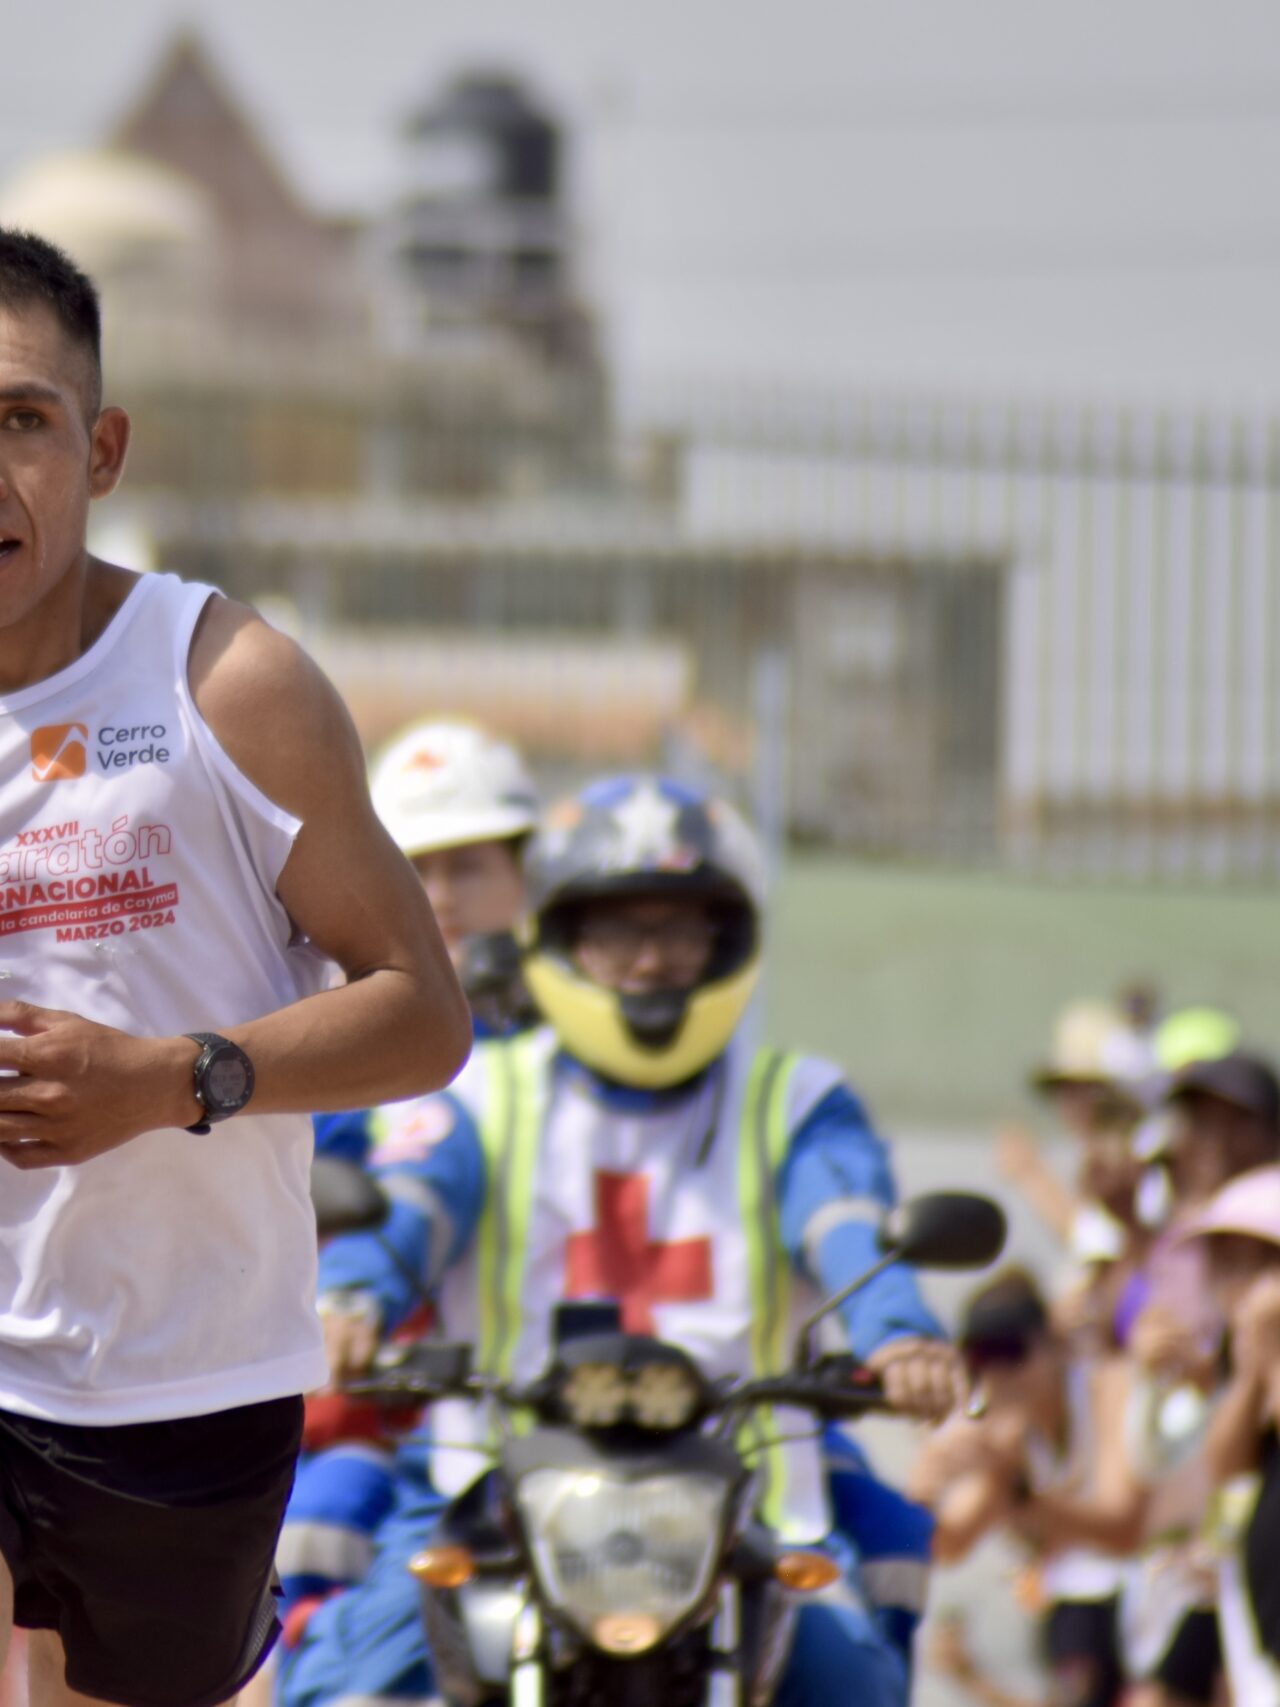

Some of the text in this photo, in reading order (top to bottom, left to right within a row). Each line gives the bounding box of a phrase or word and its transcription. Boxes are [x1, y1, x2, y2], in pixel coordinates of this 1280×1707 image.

[98, 725, 166, 746] Cerro
[97, 744, 170, 770] Verde
[16, 821, 79, 847] XXXVII
[1, 919, 16, 931] la
[18, 906, 98, 927] candelaria
[102, 902, 121, 915] de
[124, 890, 176, 910] Cayma
[56, 910, 176, 943] MARZO 2024
